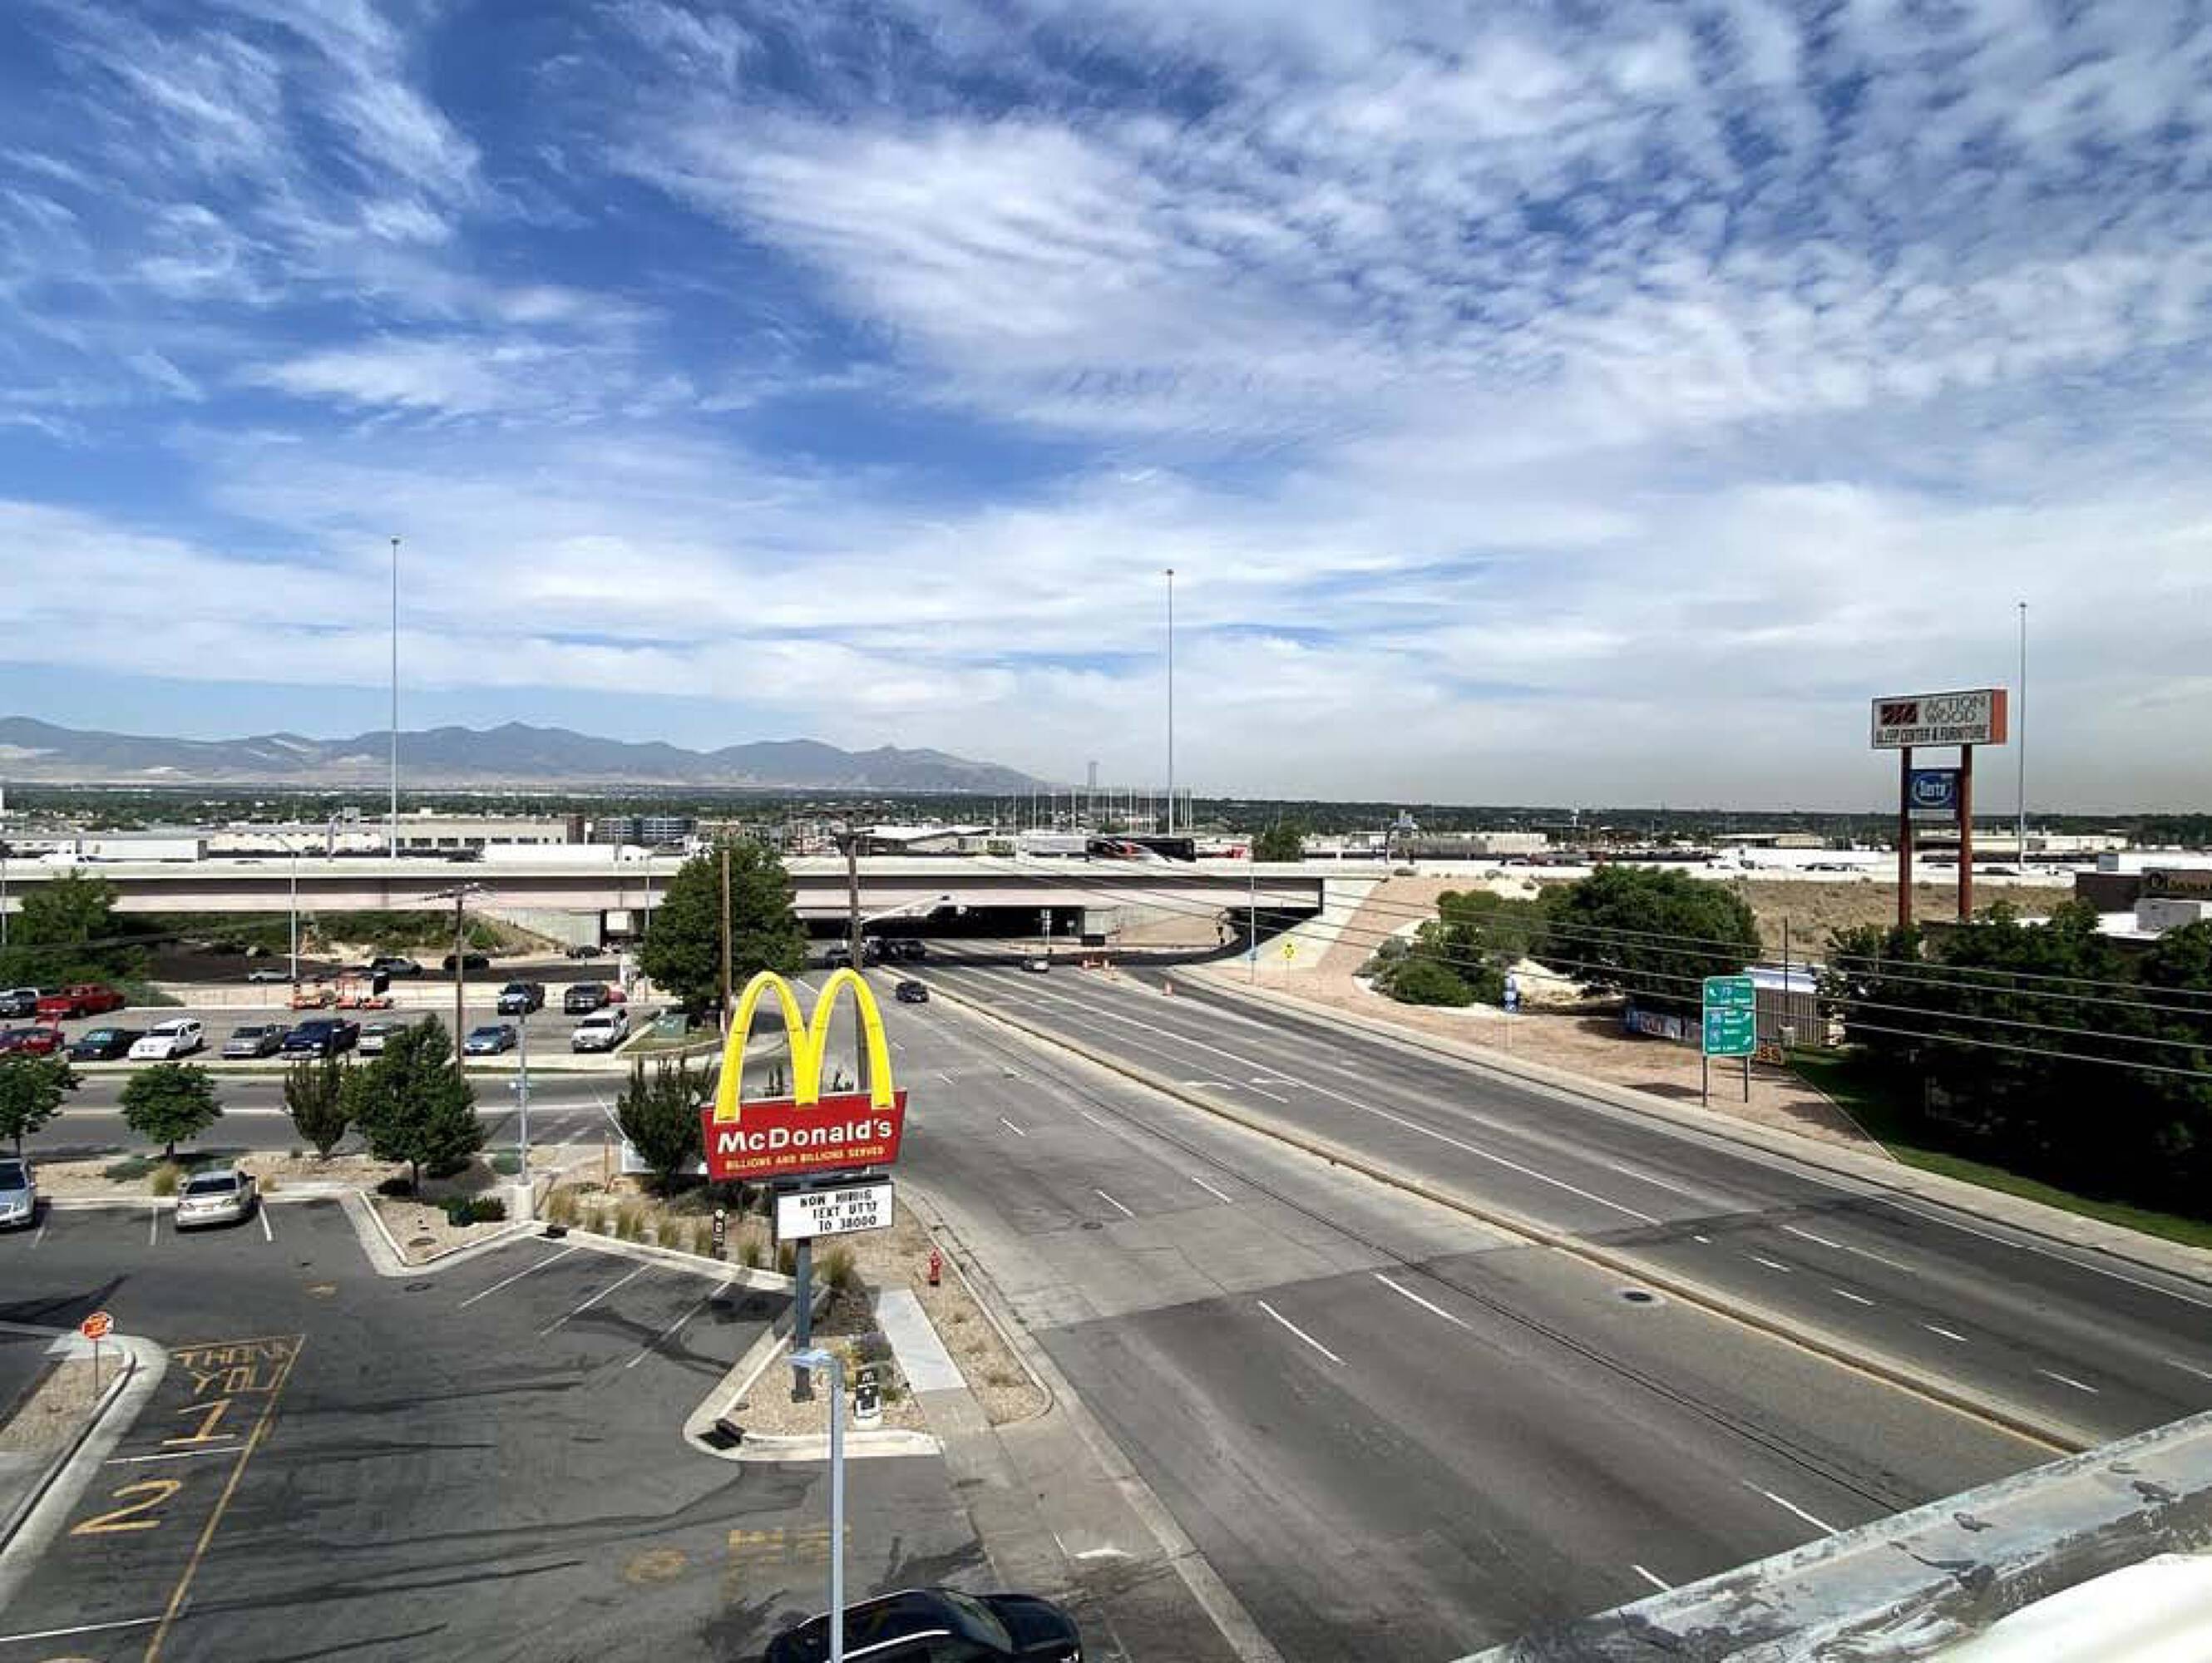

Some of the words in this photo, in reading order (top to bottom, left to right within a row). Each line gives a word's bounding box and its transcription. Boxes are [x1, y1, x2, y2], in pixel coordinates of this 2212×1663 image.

[1926, 708, 1977, 723] WOOD
[718, 1118, 893, 1155] McDonald's
[726, 1157, 771, 1171] BILLIONS
[775, 1154, 797, 1165] AND
[800, 1149, 844, 1163] BILLIONS
[847, 1146, 886, 1158] SERVED
[800, 1195, 826, 1208] NOW
[819, 1220, 832, 1232] TO
[162, 1398, 236, 1445] 1
[70, 1479, 181, 1535] 2
